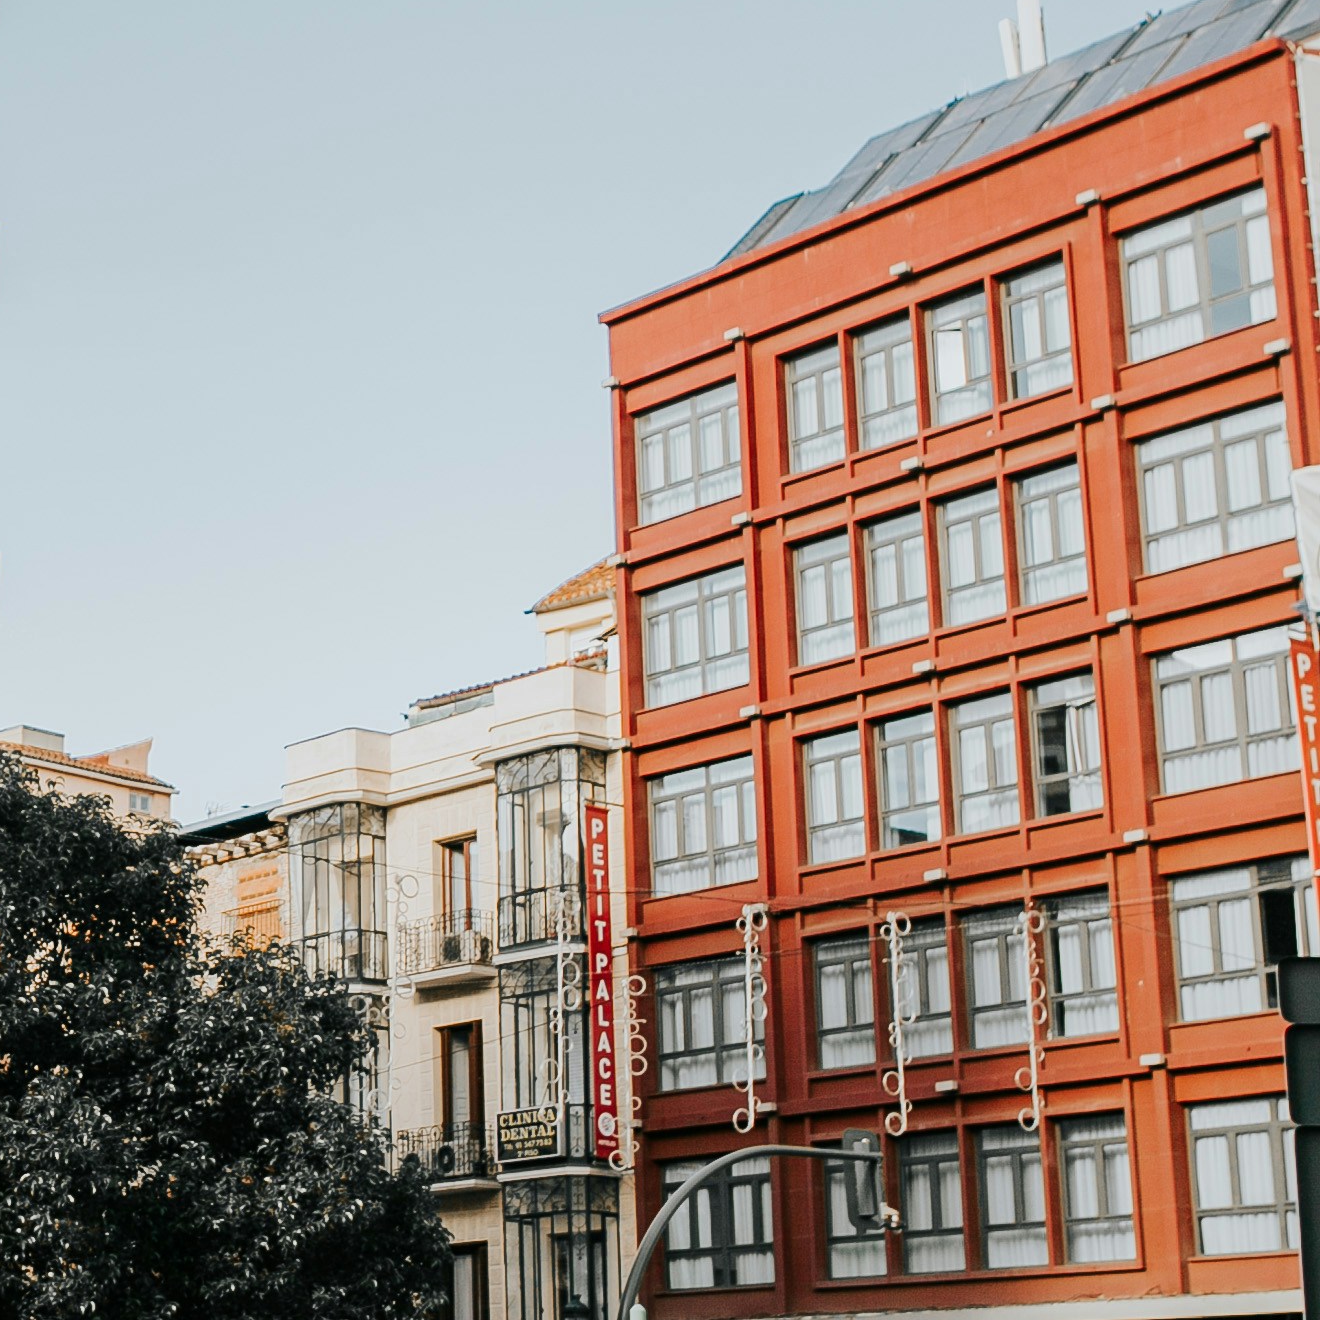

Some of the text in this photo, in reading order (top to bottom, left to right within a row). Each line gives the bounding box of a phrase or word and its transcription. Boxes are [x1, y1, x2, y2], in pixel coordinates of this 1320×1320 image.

[591, 817, 613, 1107] PETIT PALACE
[500, 1124, 556, 1142] DENTAL
